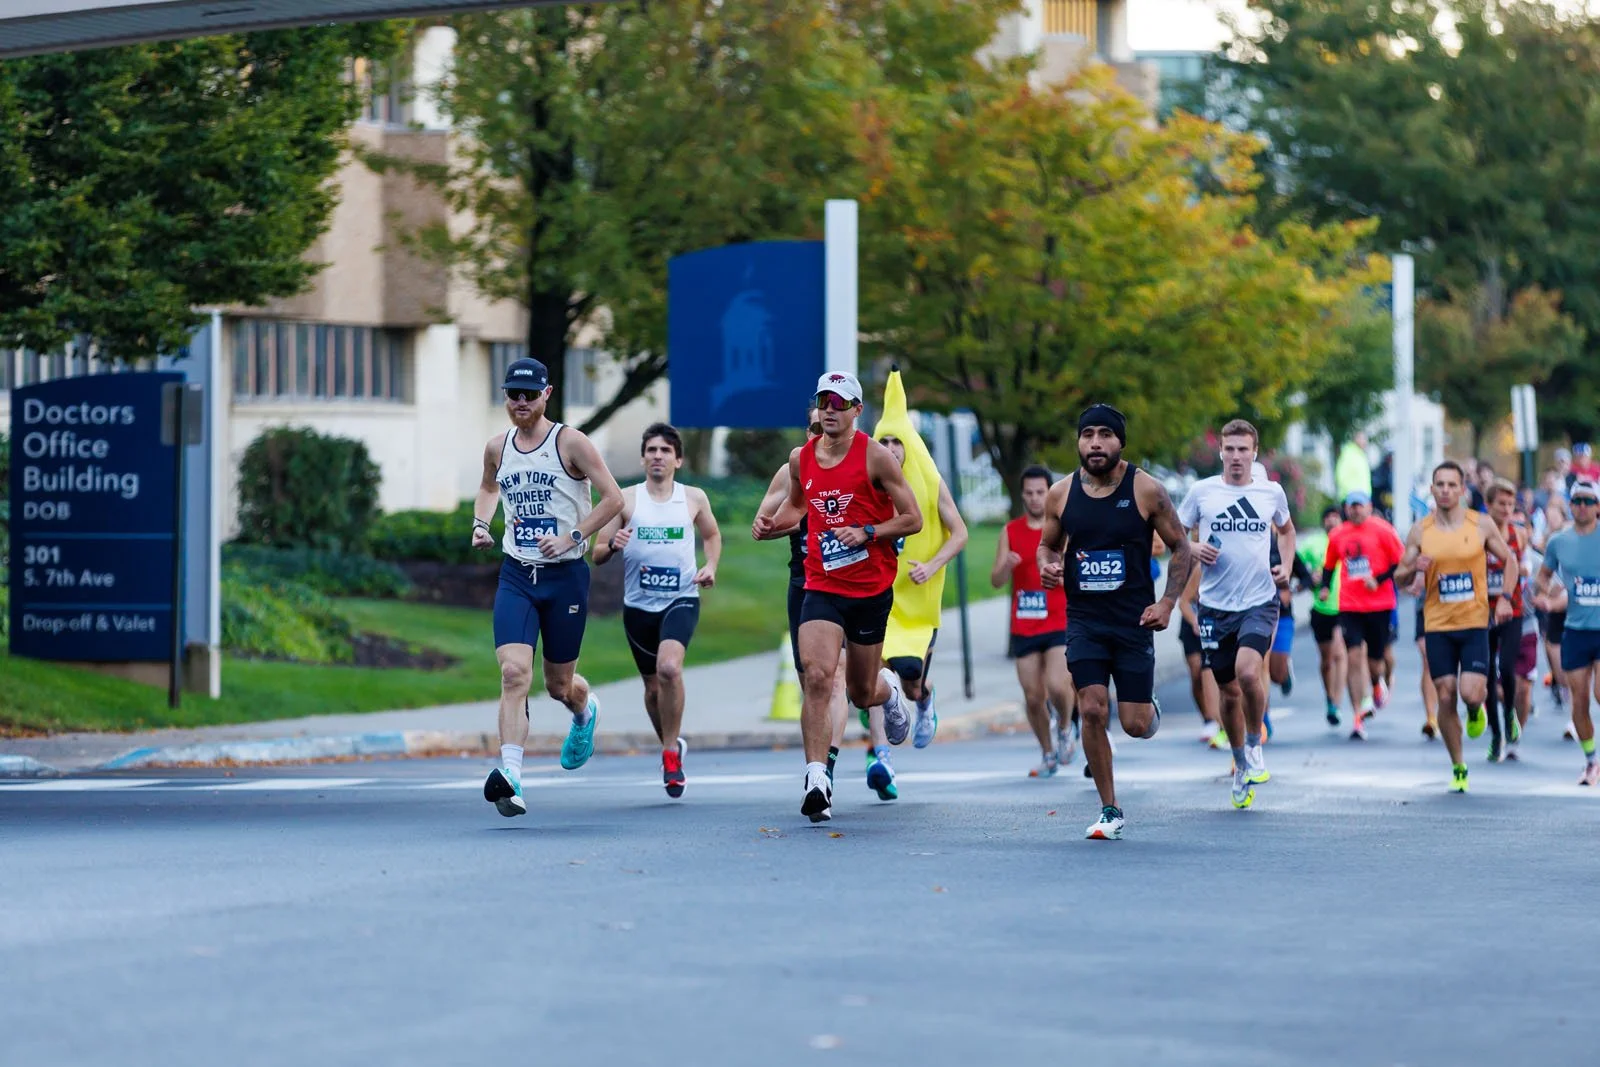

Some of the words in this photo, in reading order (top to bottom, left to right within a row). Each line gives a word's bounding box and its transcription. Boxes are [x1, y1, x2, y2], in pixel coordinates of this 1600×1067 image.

[23, 398, 135, 425] Doctors
[22, 430, 109, 459] Office
[23, 464, 140, 500] Building
[499, 473, 521, 491] NEW
[526, 471, 558, 488] YORK
[507, 490, 552, 504] PIONEER
[818, 489, 841, 497] TRACK
[23, 501, 71, 520] DOB
[516, 503, 545, 517] CLUB
[825, 516, 845, 525] CLUB
[1210, 518, 1267, 532] adidas
[516, 526, 556, 541] 2384
[638, 527, 668, 539] SPRING
[23, 545, 61, 565] 301
[1081, 560, 1122, 576] 2052
[23, 568, 41, 587] S.
[45, 568, 75, 587] 7th
[79, 569, 116, 587] Ave
[641, 573, 678, 587] 2022
[23, 613, 93, 636] Drop-off
[95, 614, 109, 632] &
[113, 614, 156, 632] Valet
